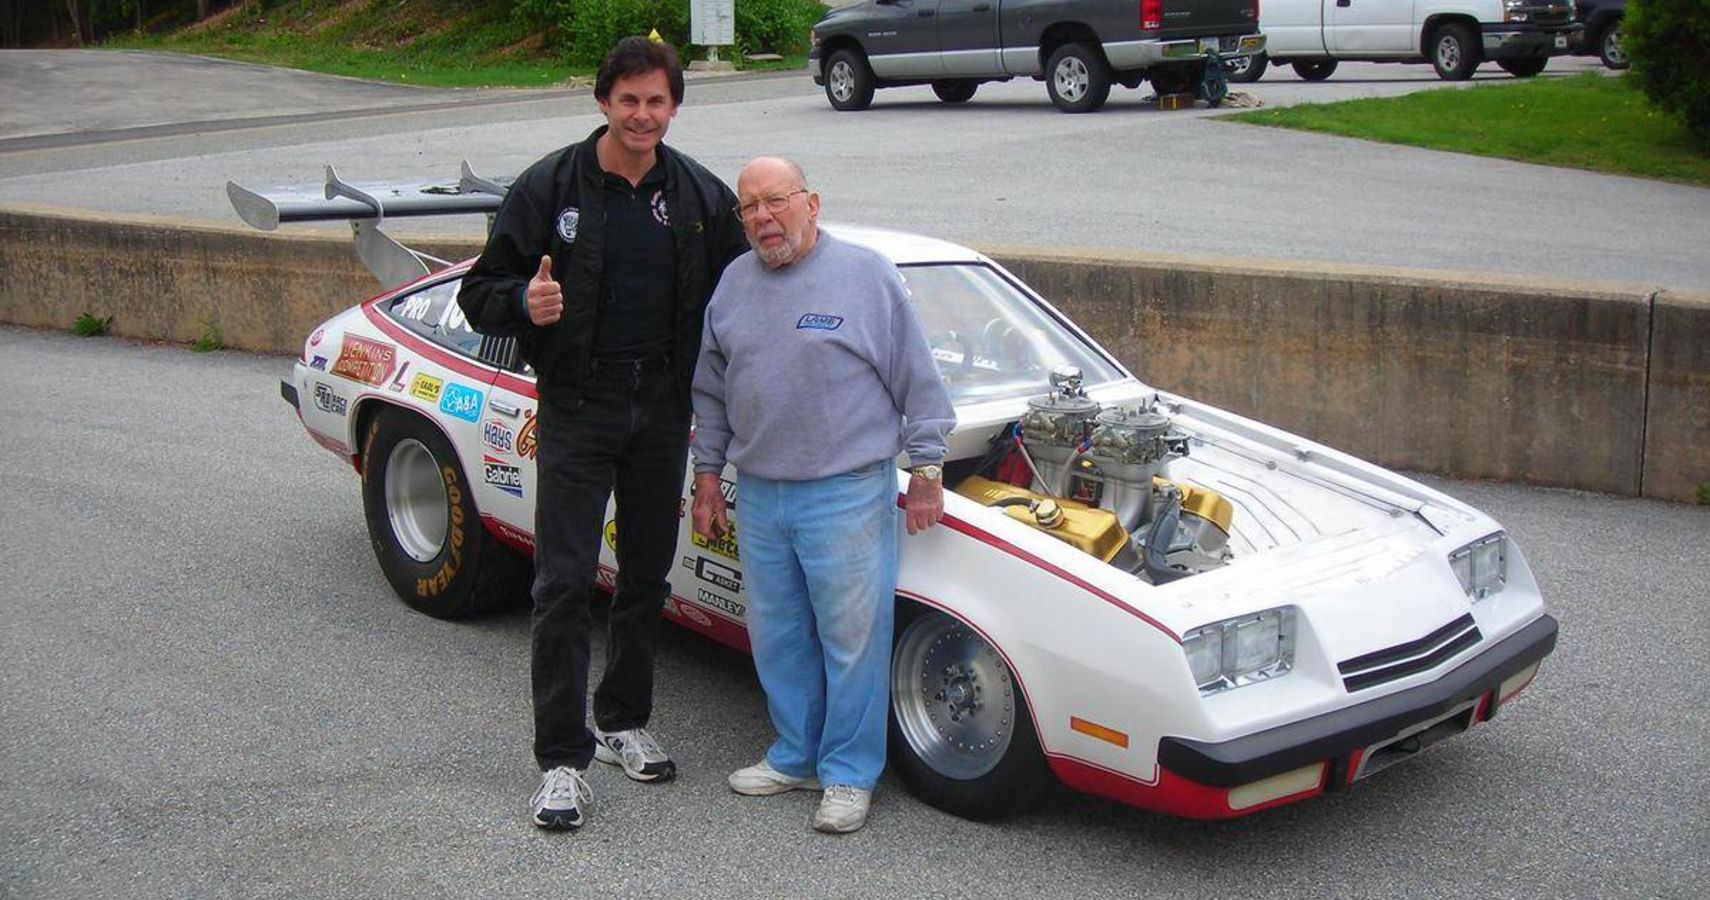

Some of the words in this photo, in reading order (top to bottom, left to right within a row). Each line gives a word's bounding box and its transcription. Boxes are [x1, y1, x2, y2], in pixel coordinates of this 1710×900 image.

[401, 295, 431, 320] PRO
[343, 341, 393, 362] JENKINS
[336, 359, 387, 383] COMPETITION
[456, 391, 480, 412] A&A
[485, 465, 522, 486] Gabriel
[416, 466, 465, 597] GOODYEAR
[698, 588, 744, 616] MANLEY
